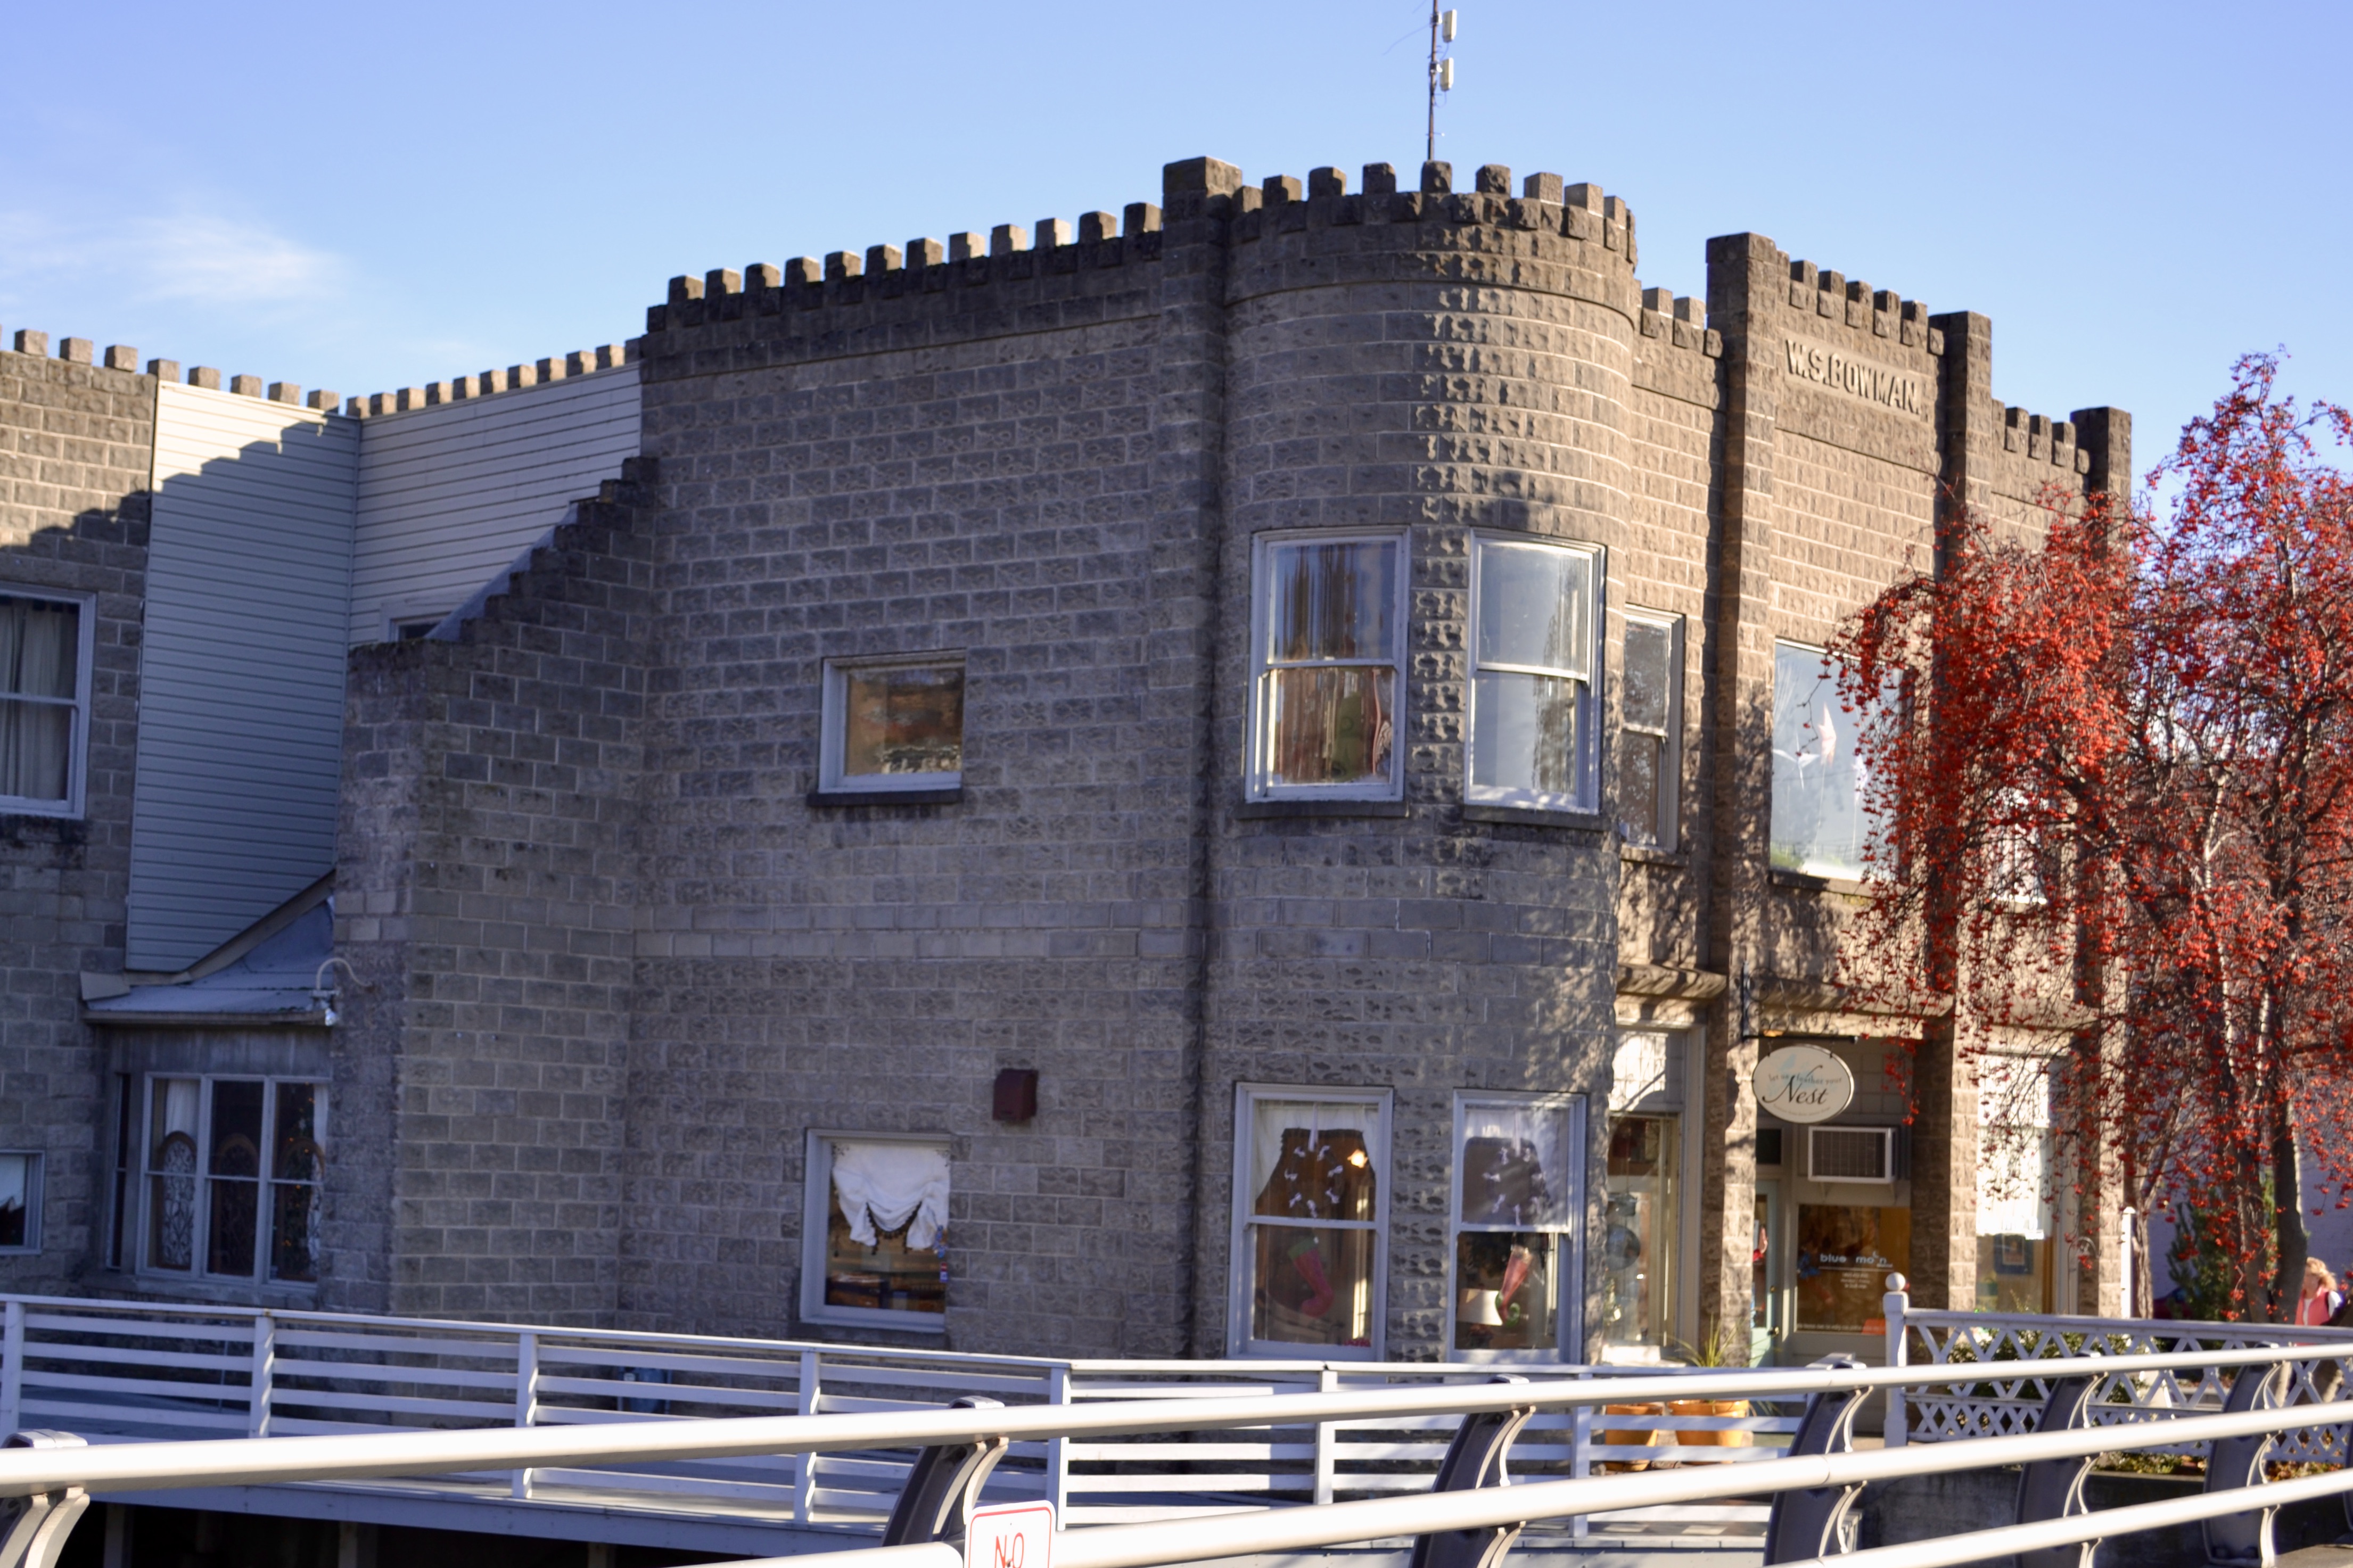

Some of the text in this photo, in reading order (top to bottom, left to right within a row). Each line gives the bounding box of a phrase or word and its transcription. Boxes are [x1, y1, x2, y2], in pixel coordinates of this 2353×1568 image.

[1762, 1064, 1828, 1105] Nest
[1796, 1072, 1823, 1085] feather
[1825, 1077, 1842, 1085] your
[1820, 1253, 1847, 1263] blue
[994, 1532, 1024, 1568] NO
